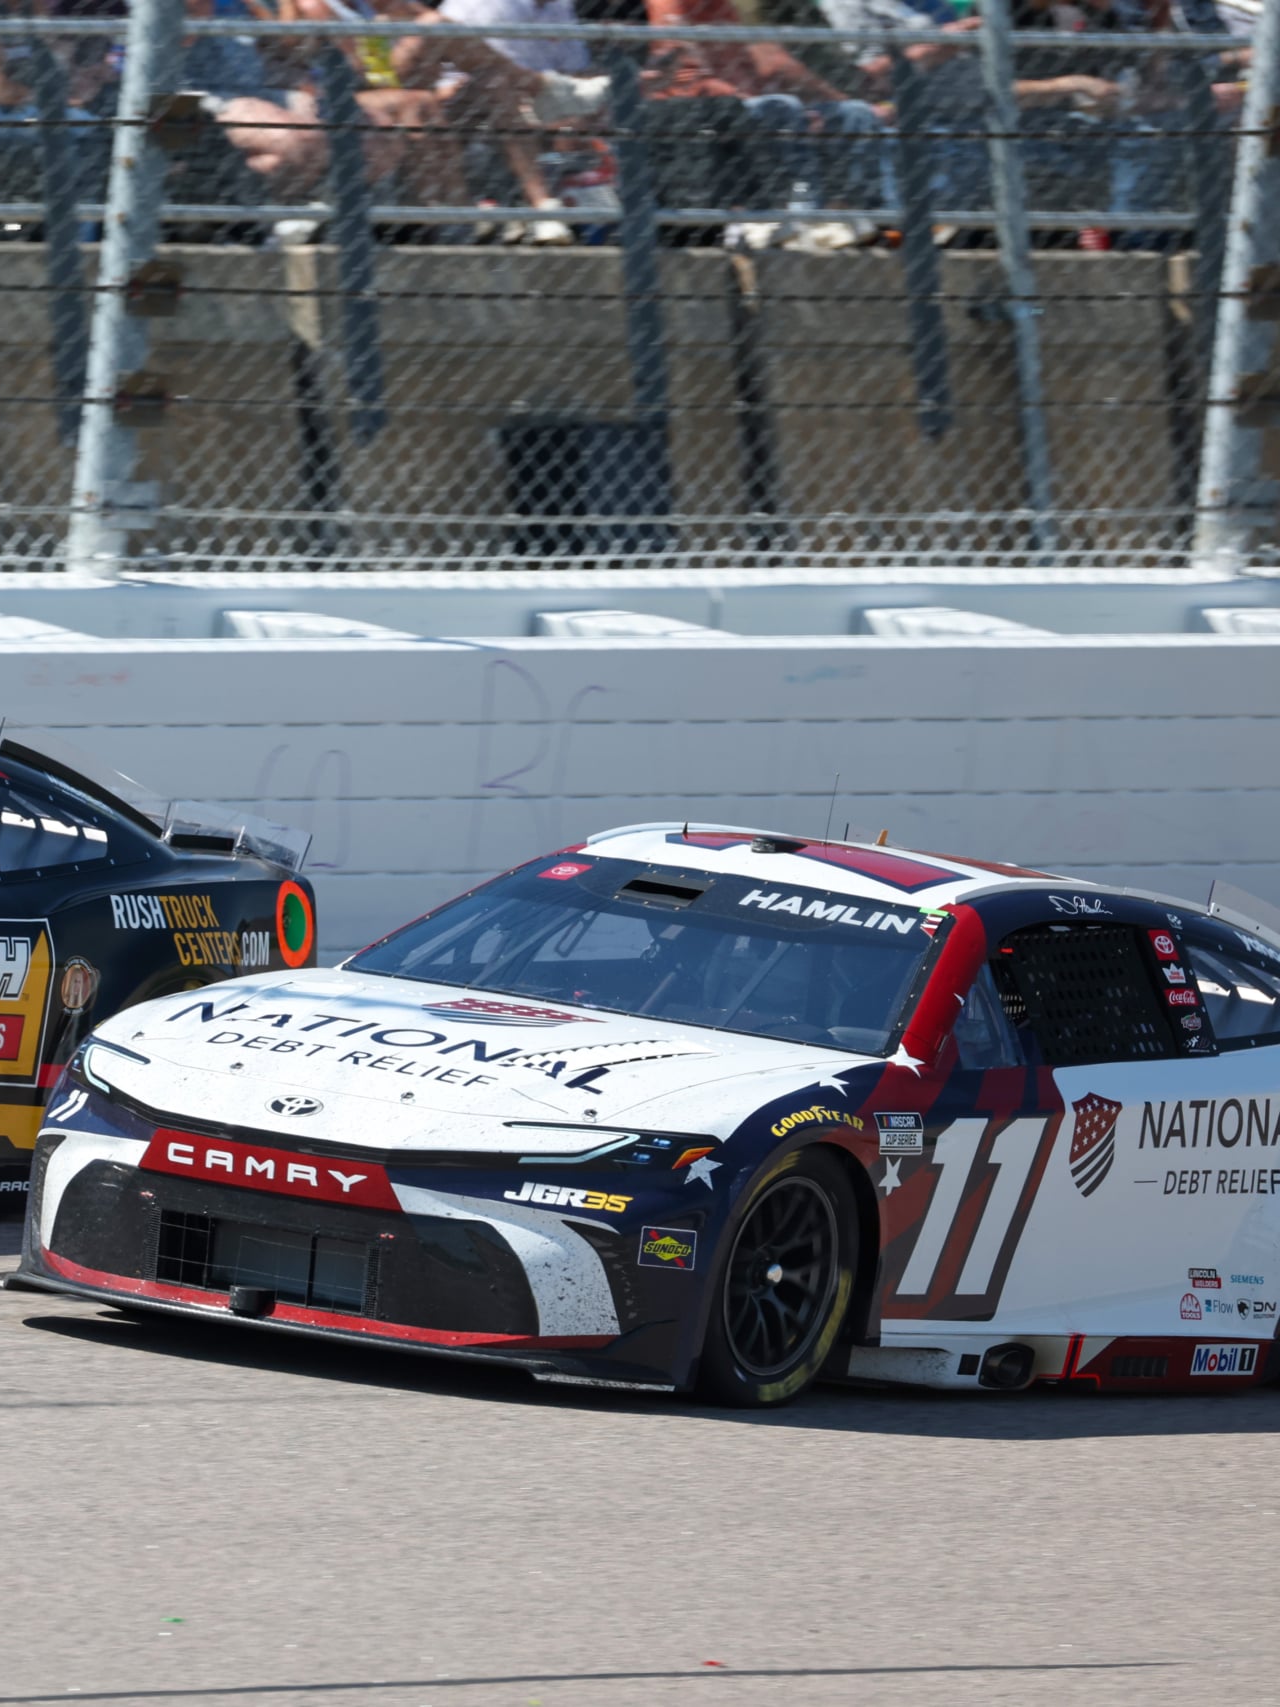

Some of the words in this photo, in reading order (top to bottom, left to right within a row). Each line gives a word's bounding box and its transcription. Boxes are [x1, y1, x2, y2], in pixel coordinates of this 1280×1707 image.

[110, 894, 220, 929] RUSHTRUCK
[739, 889, 918, 935] HAMLIN
[165, 1001, 612, 1095] NATIONAL
[206, 1031, 337, 1059] DEBT
[338, 1050, 500, 1089] RELIEF
[770, 1105, 865, 1137] GOODYEAR
[890, 1116, 916, 1128] NASCAR
[885, 1133, 897, 1146] CUP
[897, 1133, 917, 1146] SERIES
[167, 1142, 368, 1193] CAMRY
[1163, 1169, 1213, 1195] DEBT
[504, 1182, 634, 1213] JGR35
[895, 1117, 1049, 1297] 11
[645, 1242, 690, 1256] SUNOCO
[1230, 1274, 1265, 1285] SIEMENS
[1213, 1299, 1234, 1314] Flow
[1253, 1301, 1277, 1312] DN
[1192, 1347, 1239, 1372] Mobil
